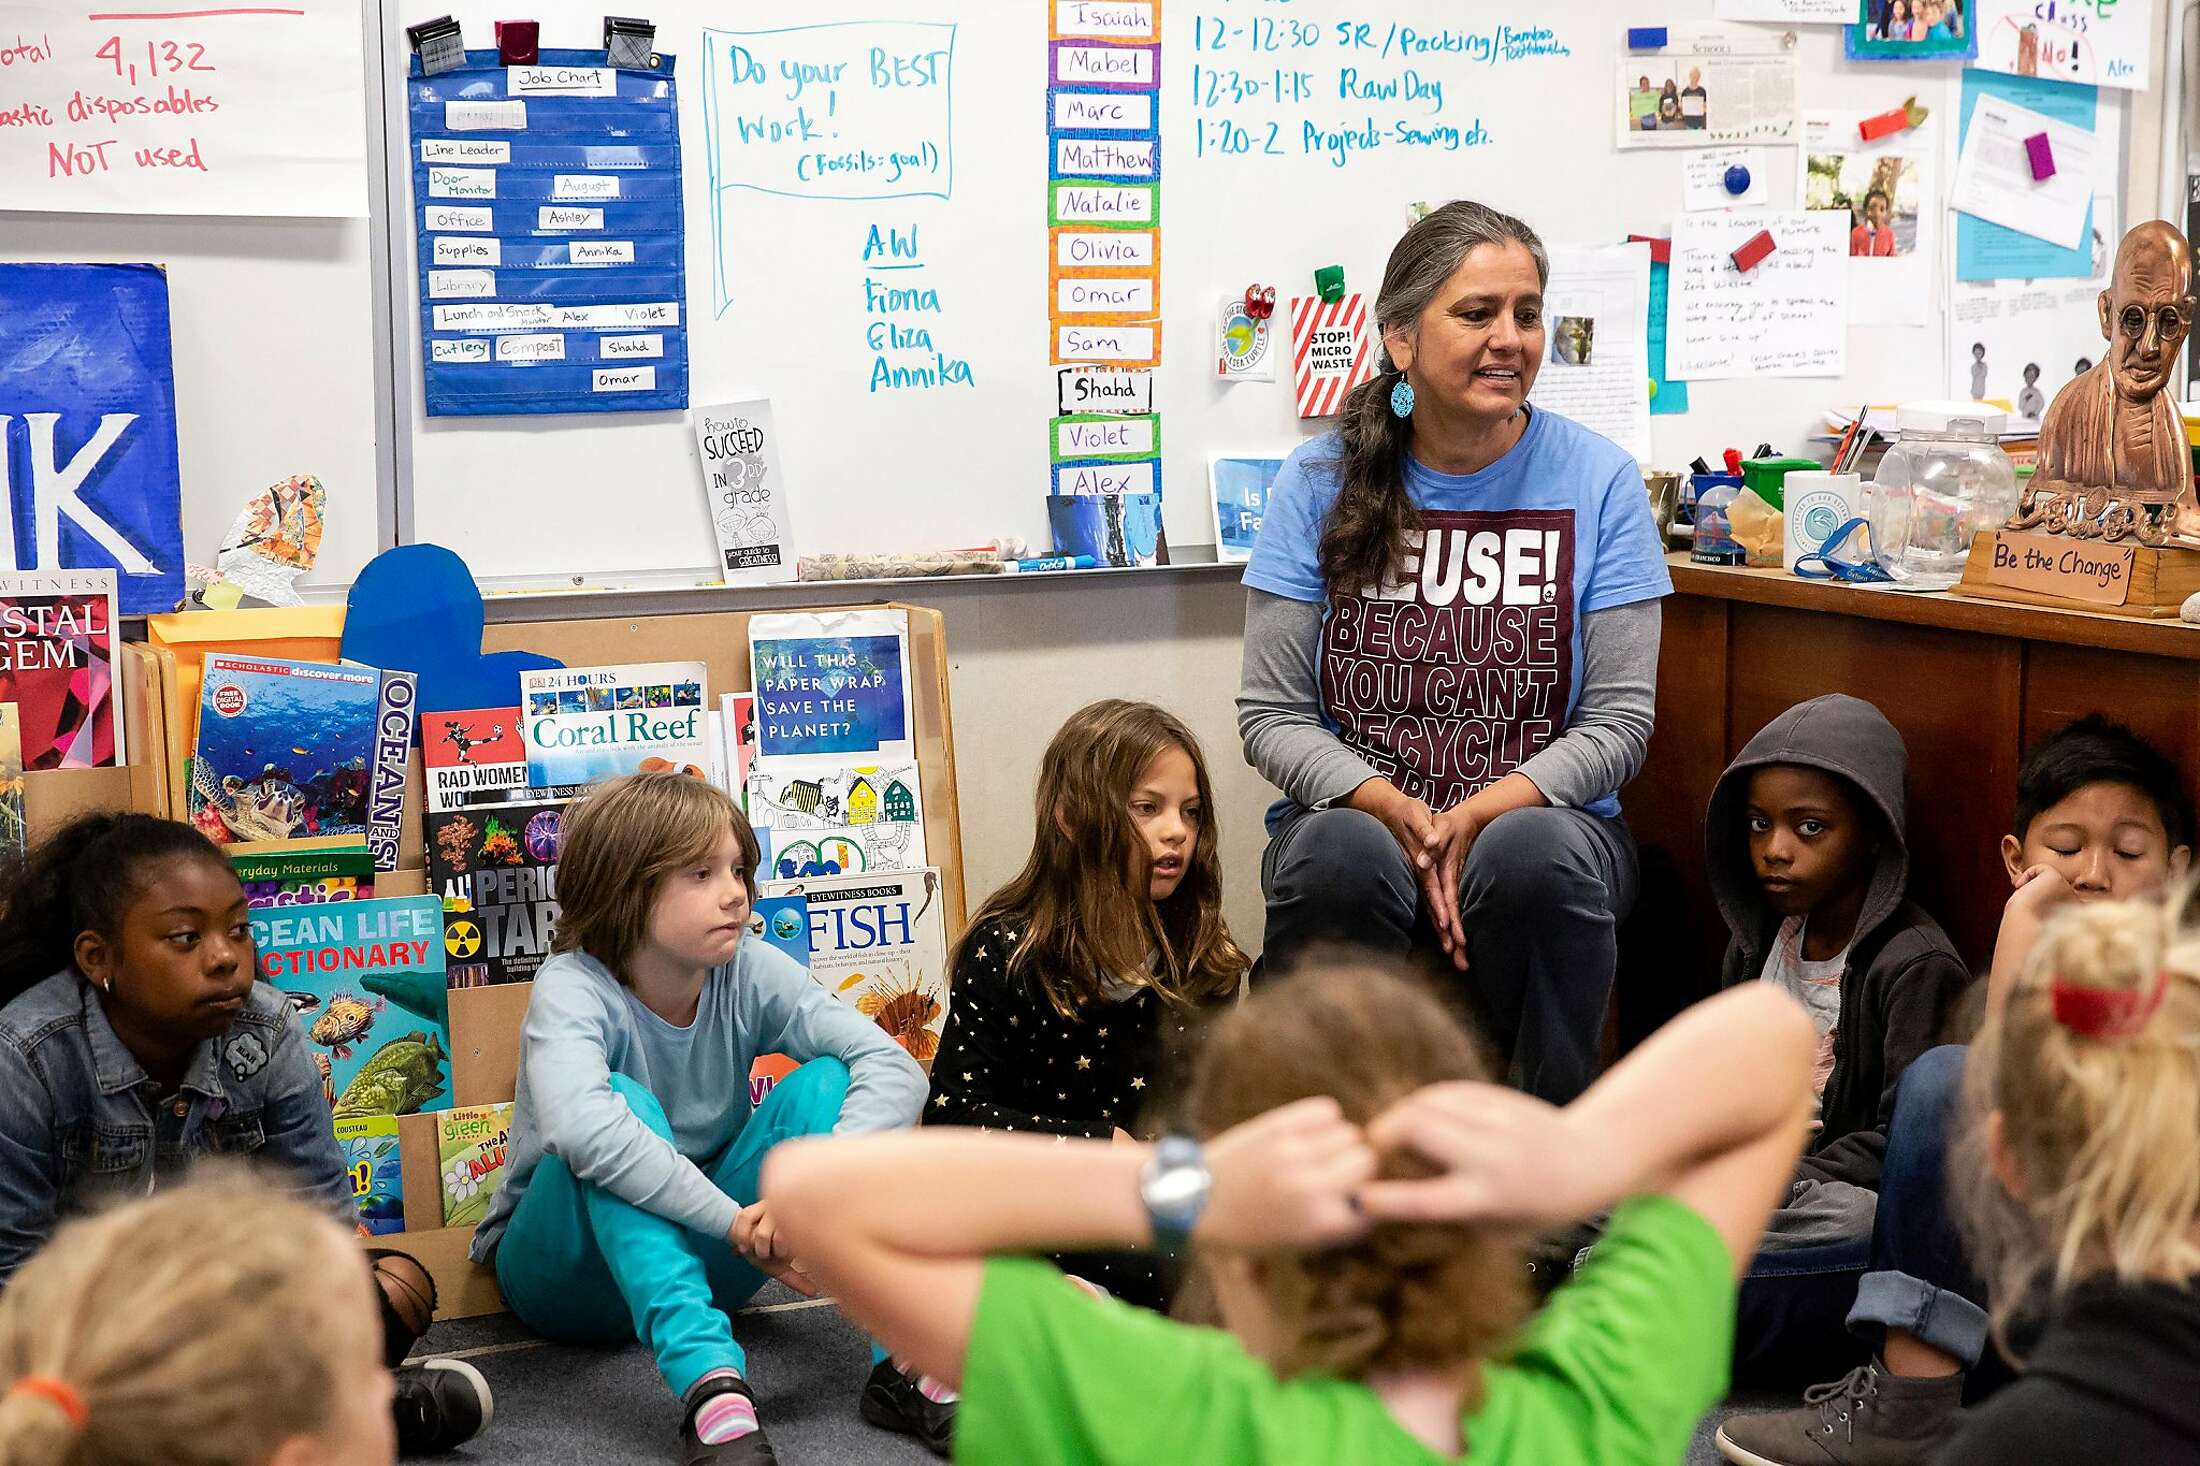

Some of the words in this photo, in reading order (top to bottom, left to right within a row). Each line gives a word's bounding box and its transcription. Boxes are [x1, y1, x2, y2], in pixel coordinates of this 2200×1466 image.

[1071, 3, 1150, 27] Isaiah
[0, 33, 51, 66] otal
[96, 36, 216, 85] 4,132
[1069, 50, 1138, 75] Mabel
[2108, 60, 2136, 77] Alex
[518, 70, 551, 85] Job
[557, 69, 602, 84] Chart
[730, 45, 766, 85] Do
[780, 58, 848, 101] your
[869, 47, 949, 89] BEST
[0, 104, 53, 127] astic
[67, 85, 219, 123] disposables
[1067, 101, 1125, 120] Marc
[1197, 118, 1285, 158] 1:20-2
[50, 140, 117, 178] NOT
[135, 138, 208, 171] used
[425, 144, 454, 156] Line
[460, 143, 504, 156] Leader
[1063, 144, 1154, 170] Matthew
[432, 171, 469, 186] Door
[562, 178, 610, 194] August
[449, 184, 493, 195] Monitor
[1063, 191, 1141, 216] Natalie
[437, 212, 485, 227] Office
[549, 211, 590, 225] Ashley
[438, 244, 488, 258] Supplies
[862, 223, 918, 261] AW
[1071, 237, 1140, 261] Olivia
[436, 275, 487, 292] Library
[862, 278, 942, 313] Fiona
[1072, 287, 1141, 304] Omar
[442, 308, 483, 322] Lunch
[487, 306, 504, 319] and
[562, 311, 589, 323] Alex
[625, 306, 667, 320] Violet
[608, 340, 649, 352] Shahd
[867, 322, 933, 352] Eliza
[1068, 331, 1122, 352] Sam
[1311, 331, 1351, 344] STOP!
[1311, 346, 1351, 357] MICRO
[870, 353, 975, 392] Annika
[1312, 358, 1353, 370] WASTE
[599, 375, 640, 386] Omar
[1075, 378, 1136, 401] Shahd
[704, 427, 764, 461] SUCCEED
[1070, 425, 1129, 448] Violet
[713, 472, 728, 489] IN
[1073, 470, 1131, 495] Alex
[723, 483, 771, 509] grade
[1244, 487, 1260, 507] Is
[1240, 511, 1262, 531] Fa
[1365, 529, 1561, 606] EUSE!
[2024, 548, 2053, 571] the
[0, 577, 109, 591] WITNESS
[2, 604, 107, 639] STAL
[1330, 595, 1558, 665] BECAUSE
[763, 655, 807, 668] WILL
[814, 654, 857, 667] THIS
[225, 663, 289, 674] SCHOLASTIC
[291, 668, 340, 680] discover
[343, 674, 374, 684] more
[548, 676, 561, 687] 24
[566, 672, 617, 686] HOURS
[766, 678, 821, 692] PAPER
[831, 675, 882, 689] WRAP
[1328, 655, 1412, 713] YOU
[1425, 667, 1558, 720] CAN'T
[767, 702, 813, 715] SAVE
[821, 699, 856, 712] THE
[533, 714, 618, 749] Coral
[625, 708, 701, 742] Reef
[769, 723, 850, 738] PLANET?
[437, 770, 470, 788] RAD
[473, 766, 527, 785] WOMEN
[439, 790, 464, 808] WO
[370, 827, 398, 839] AND
[237, 864, 278, 879] eryday
[282, 862, 338, 874] Materials
[811, 889, 866, 902] EYEWITNESS
[867, 887, 897, 896] BOOKS
[250, 914, 351, 948] CEAN
[357, 907, 436, 938] LIFE
[807, 903, 915, 952] FISH
[262, 940, 430, 977] CTIONARY
[453, 1111, 478, 1121] Little
[336, 1124, 368, 1134] COUSTEAU
[444, 1120, 492, 1141] green
[468, 1145, 509, 1181] ALU
